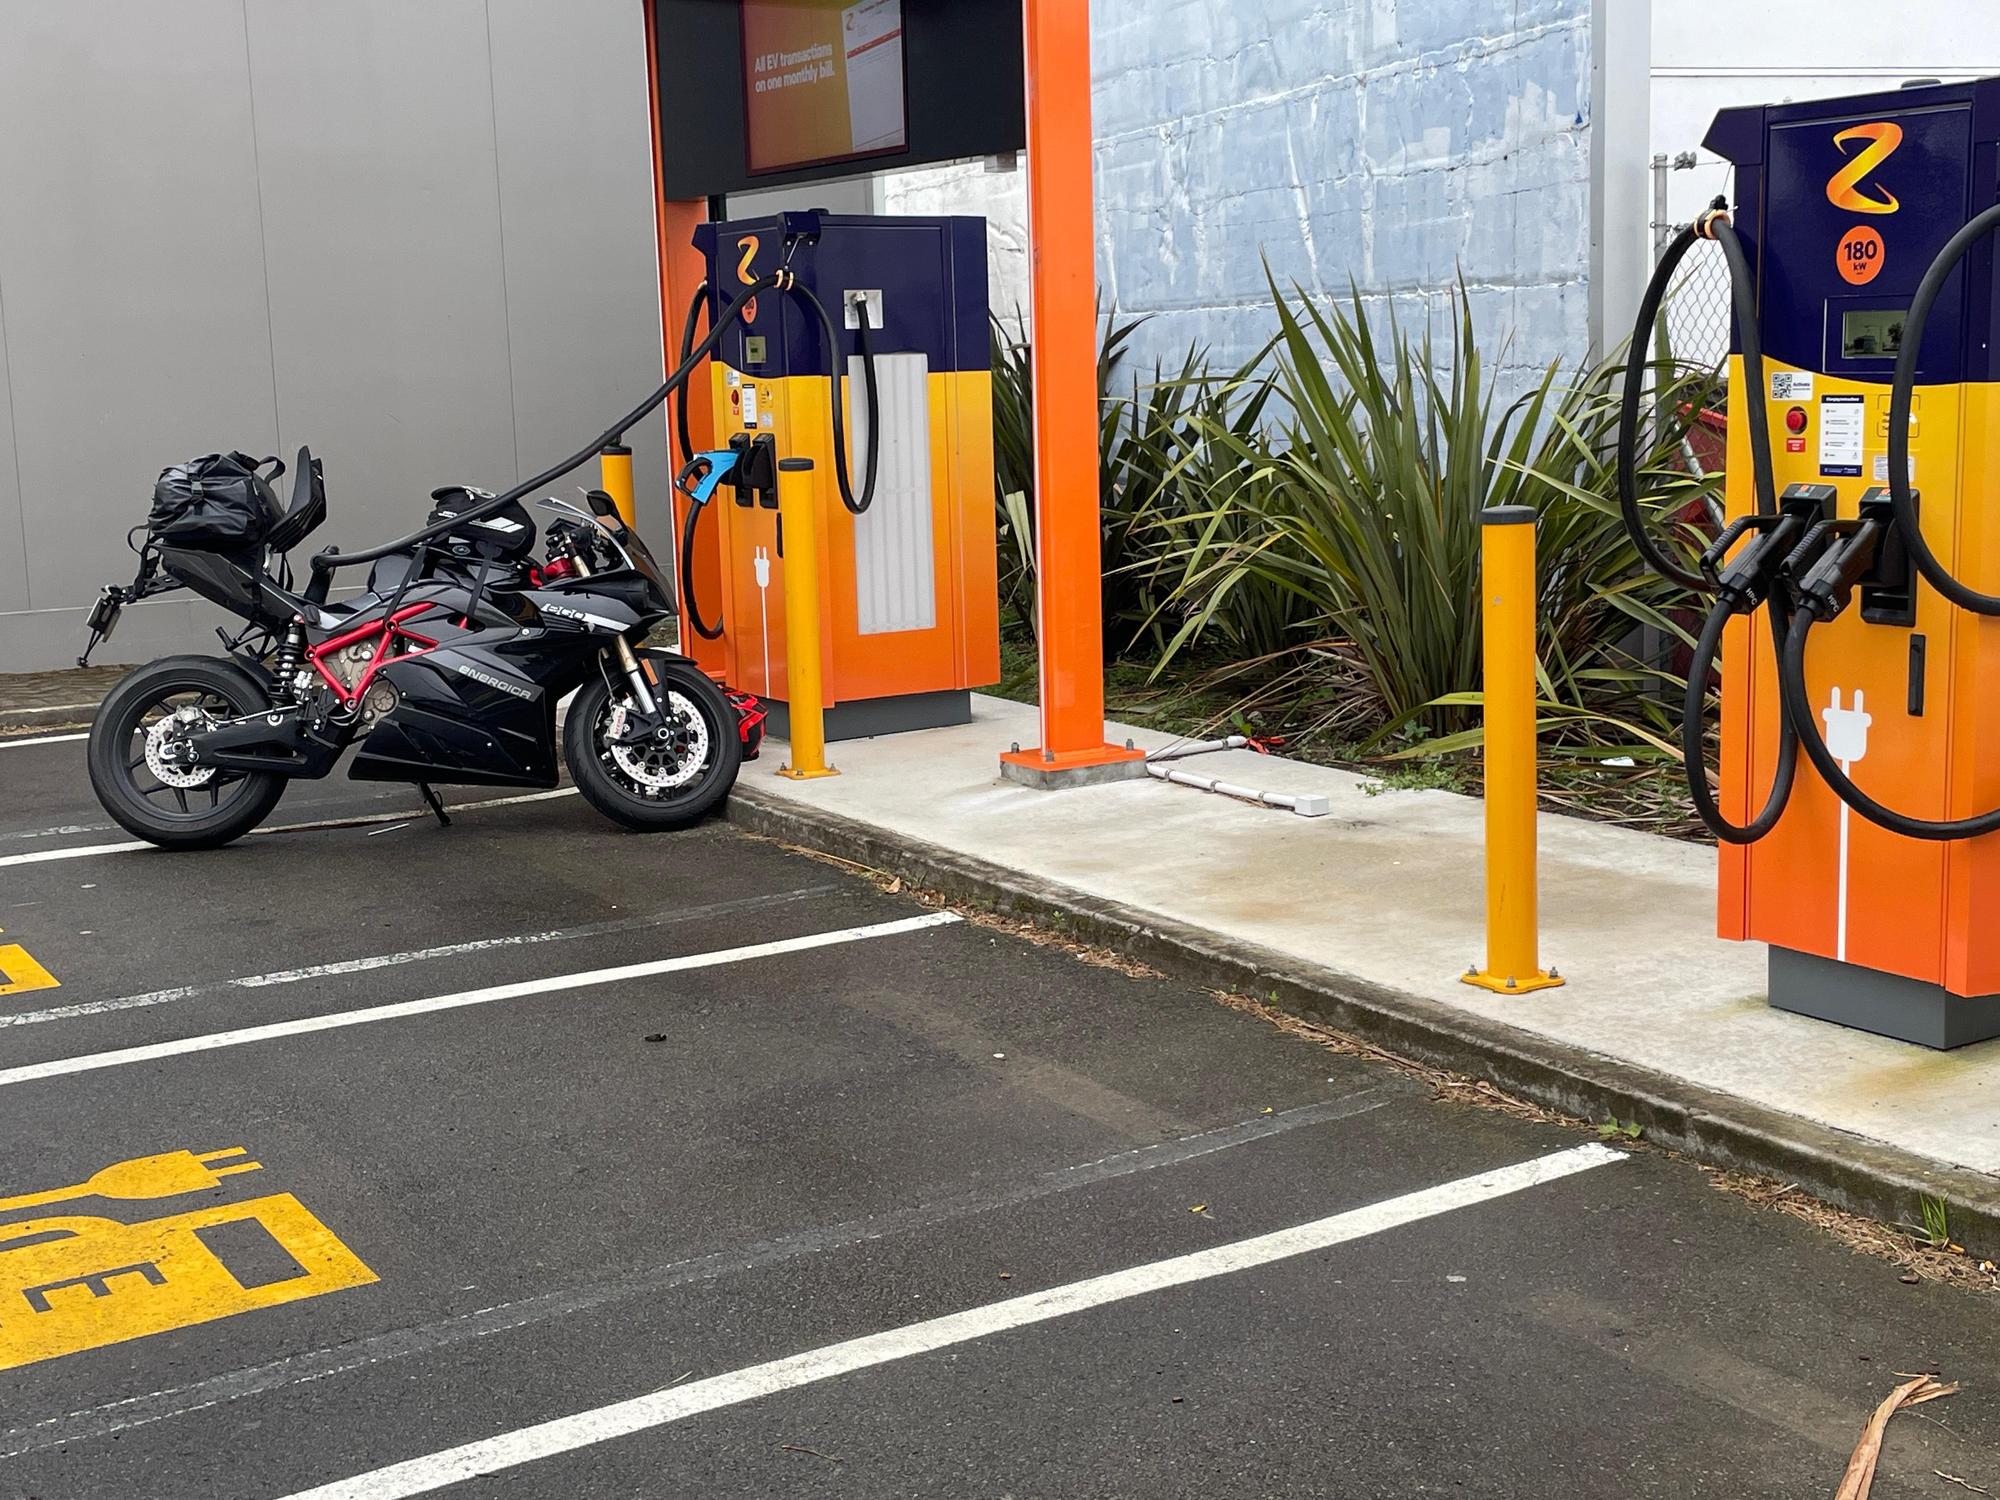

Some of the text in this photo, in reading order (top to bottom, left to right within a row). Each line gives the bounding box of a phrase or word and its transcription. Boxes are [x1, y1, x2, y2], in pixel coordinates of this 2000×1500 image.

[755, 55, 766, 72] All
[767, 53, 779, 69] EV
[780, 43, 833, 66] transactions
[755, 60, 835, 93] on one monthly bill.
[1844, 240, 1877, 261] 180
[1853, 262, 1867, 271] kW
[1745, 587, 1758, 605] HPC
[1827, 594, 1840, 613] HPC
